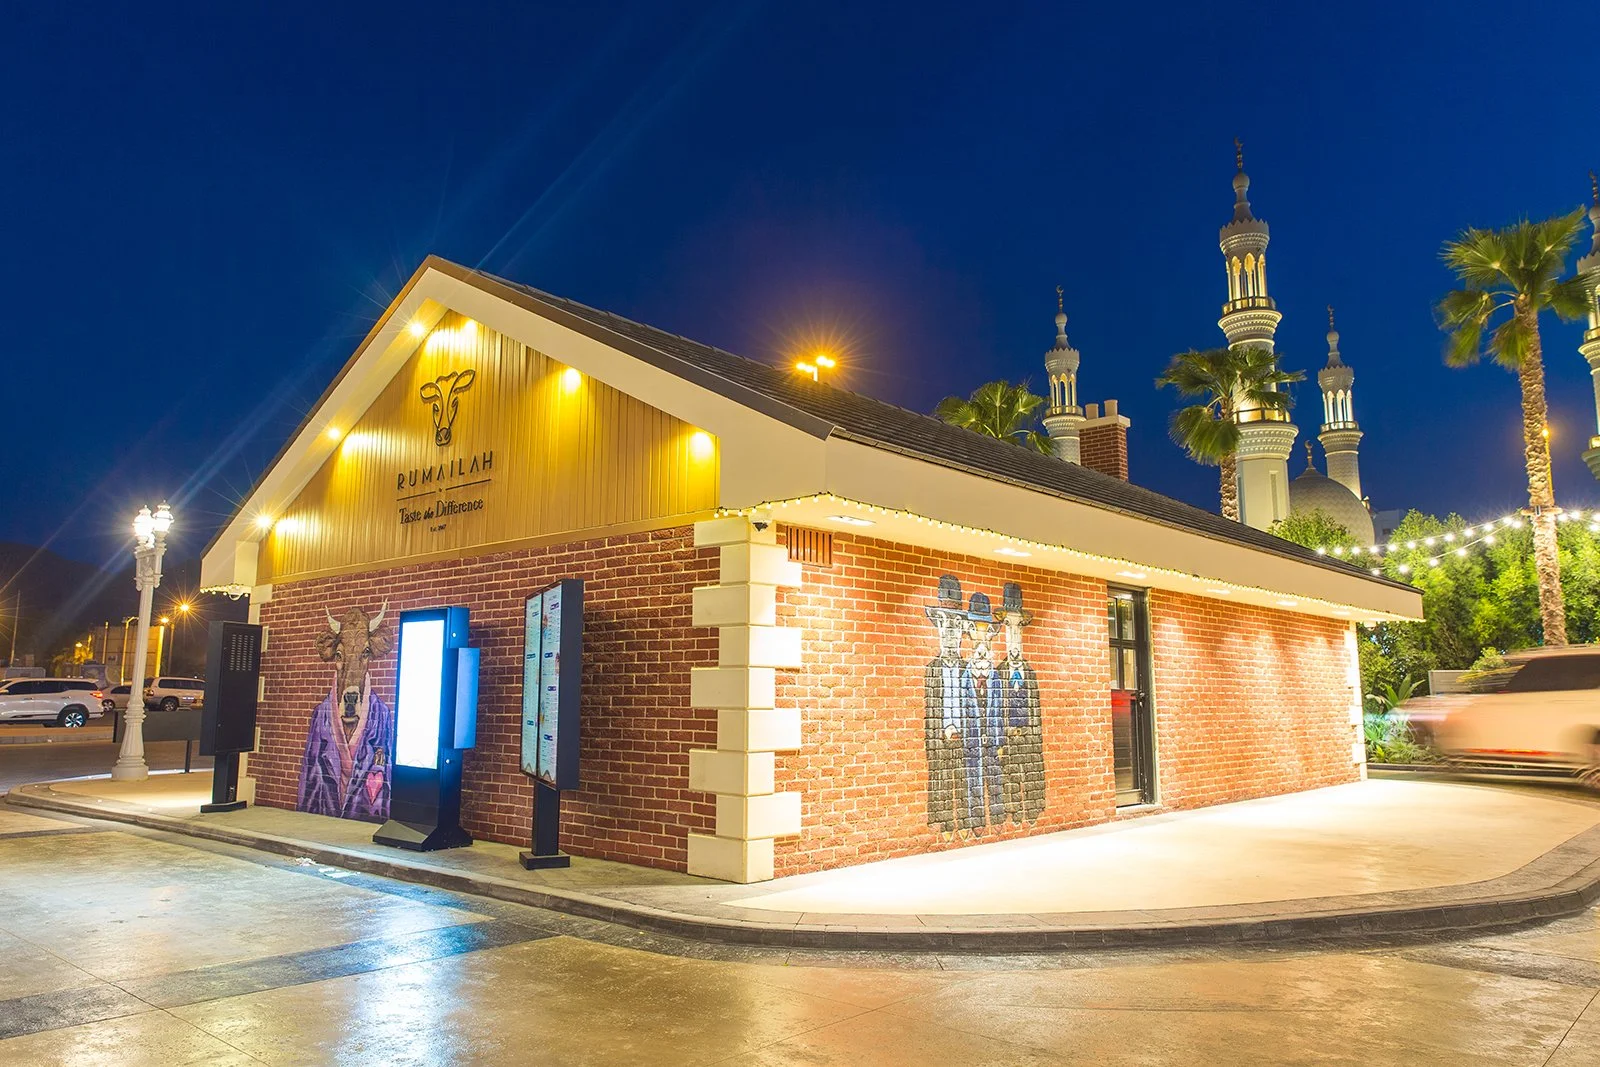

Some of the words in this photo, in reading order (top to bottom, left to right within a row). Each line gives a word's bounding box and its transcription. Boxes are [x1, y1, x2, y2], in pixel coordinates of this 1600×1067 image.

[397, 451, 493, 490] RUMAILAH
[399, 507, 422, 524] Taste
[435, 499, 484, 518] Difference
